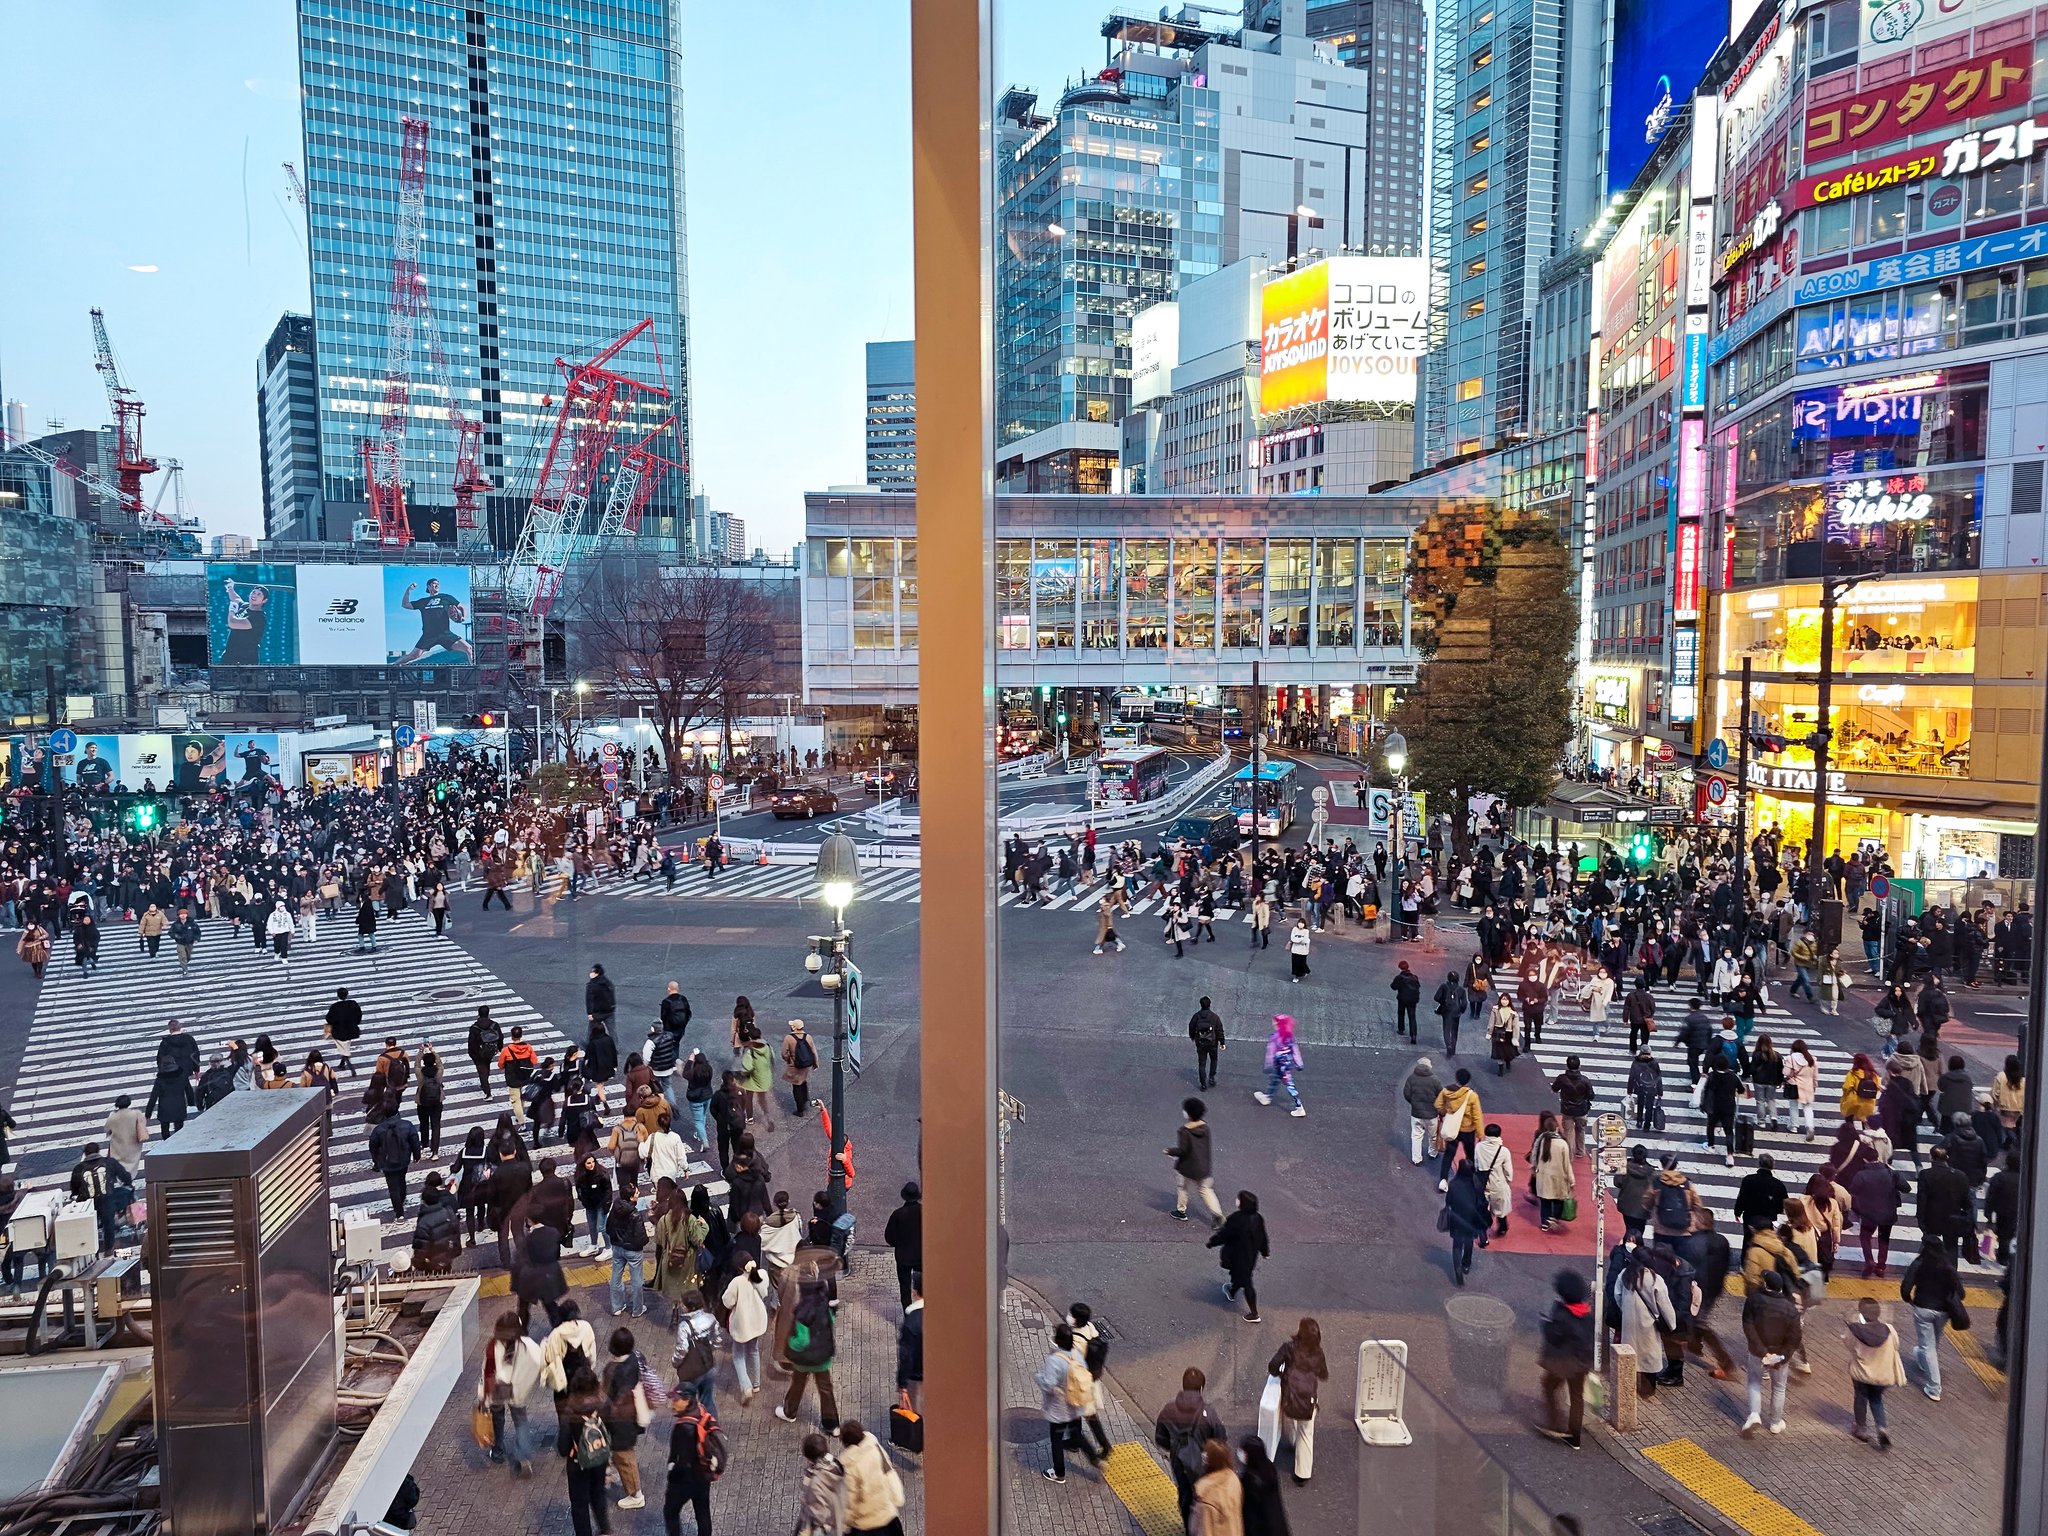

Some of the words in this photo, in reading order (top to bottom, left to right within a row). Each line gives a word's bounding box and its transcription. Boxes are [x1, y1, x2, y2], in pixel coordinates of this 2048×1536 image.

[1807, 58, 2025, 149] コンタクト
[1086, 112, 1122, 125] TOKYU
[1123, 118, 1158, 131] PLAZA
[1941, 119, 2048, 177] ガスト
[1694, 231, 1706, 292] 献血ルーム
[1334, 284, 1416, 305] ココロの
[1800, 270, 1862, 299] AEON
[1264, 307, 1327, 352] カラオケ
[1333, 308, 1429, 330] ボリューム
[1264, 337, 1326, 374] JOYSOUND
[1886, 475, 1926, 494] 焼肉
[1836, 494, 1933, 525] Ushi8
